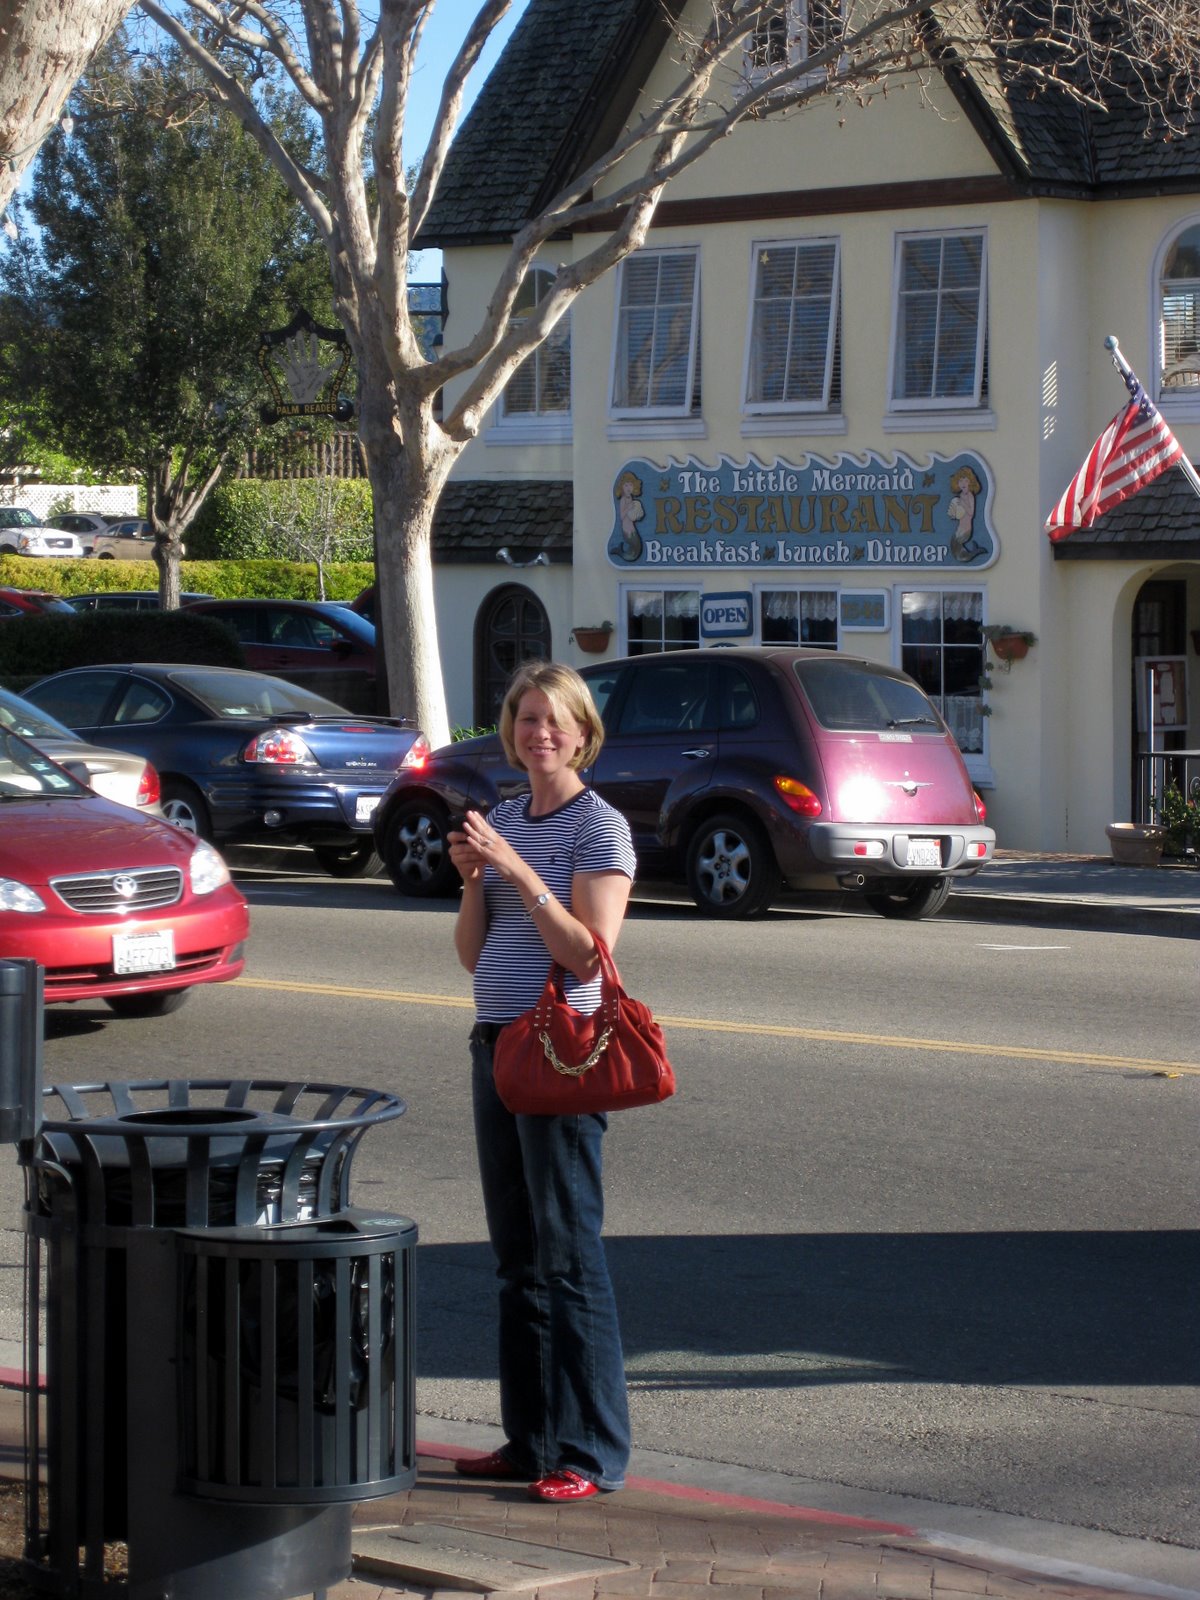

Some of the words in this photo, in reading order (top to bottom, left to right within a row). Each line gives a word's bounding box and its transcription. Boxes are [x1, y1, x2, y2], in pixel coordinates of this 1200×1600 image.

[337, 342, 350, 379] FUTURE
[330, 379, 341, 403] TOLD
[276, 405, 300, 415] PALM
[304, 403, 337, 413] READER
[678, 471, 721, 493] The
[733, 469, 798, 493] Little
[811, 468, 914, 492] Mermaid
[654, 494, 941, 534] RESTAURANT
[645, 539, 761, 563] Breakfast
[777, 539, 850, 563] Lunch
[867, 538, 948, 563] Dinner
[703, 607, 748, 624] OPEN
